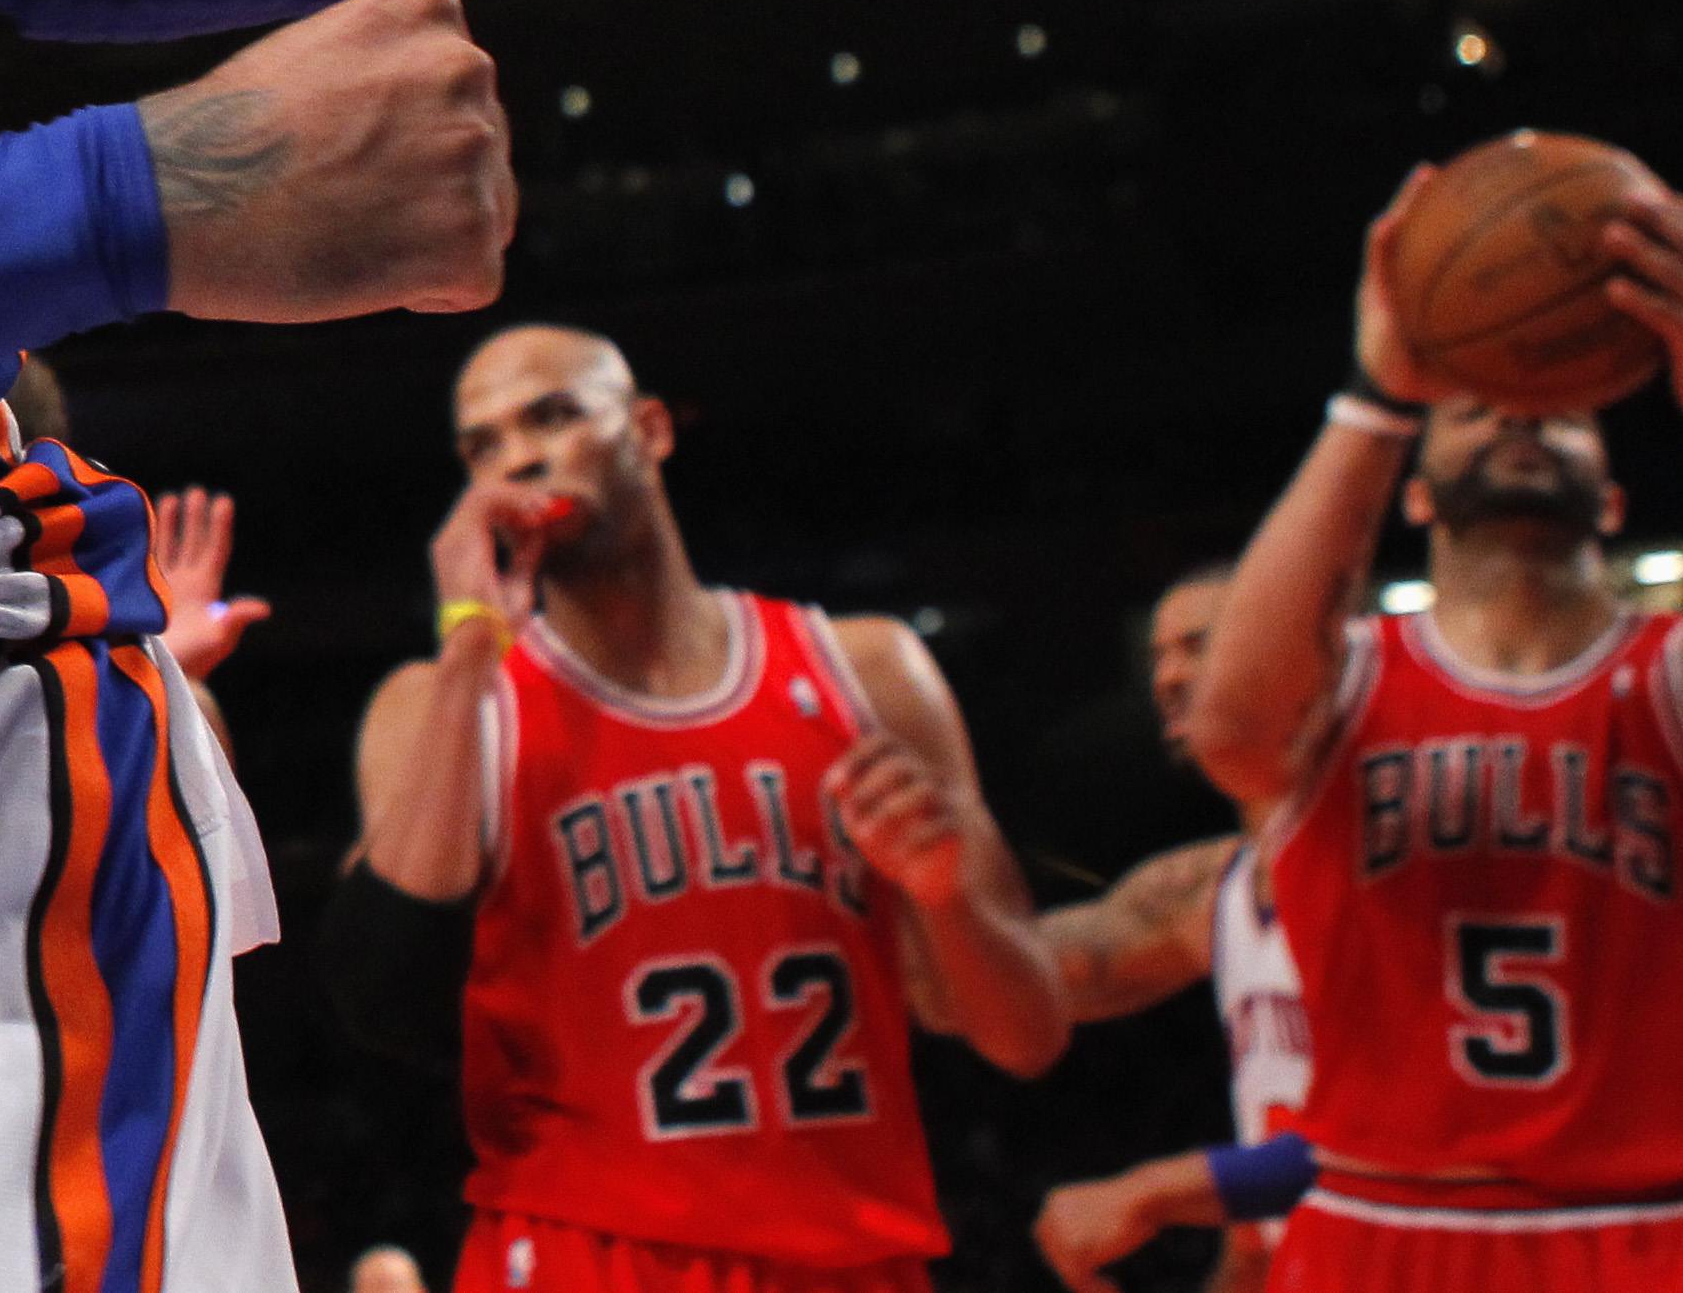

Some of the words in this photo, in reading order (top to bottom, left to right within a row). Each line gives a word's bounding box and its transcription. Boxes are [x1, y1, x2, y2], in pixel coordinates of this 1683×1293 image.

[1360, 733, 1677, 904] BULLS
[626, 937, 876, 1141] 22
[1443, 913, 1573, 1091] 5
